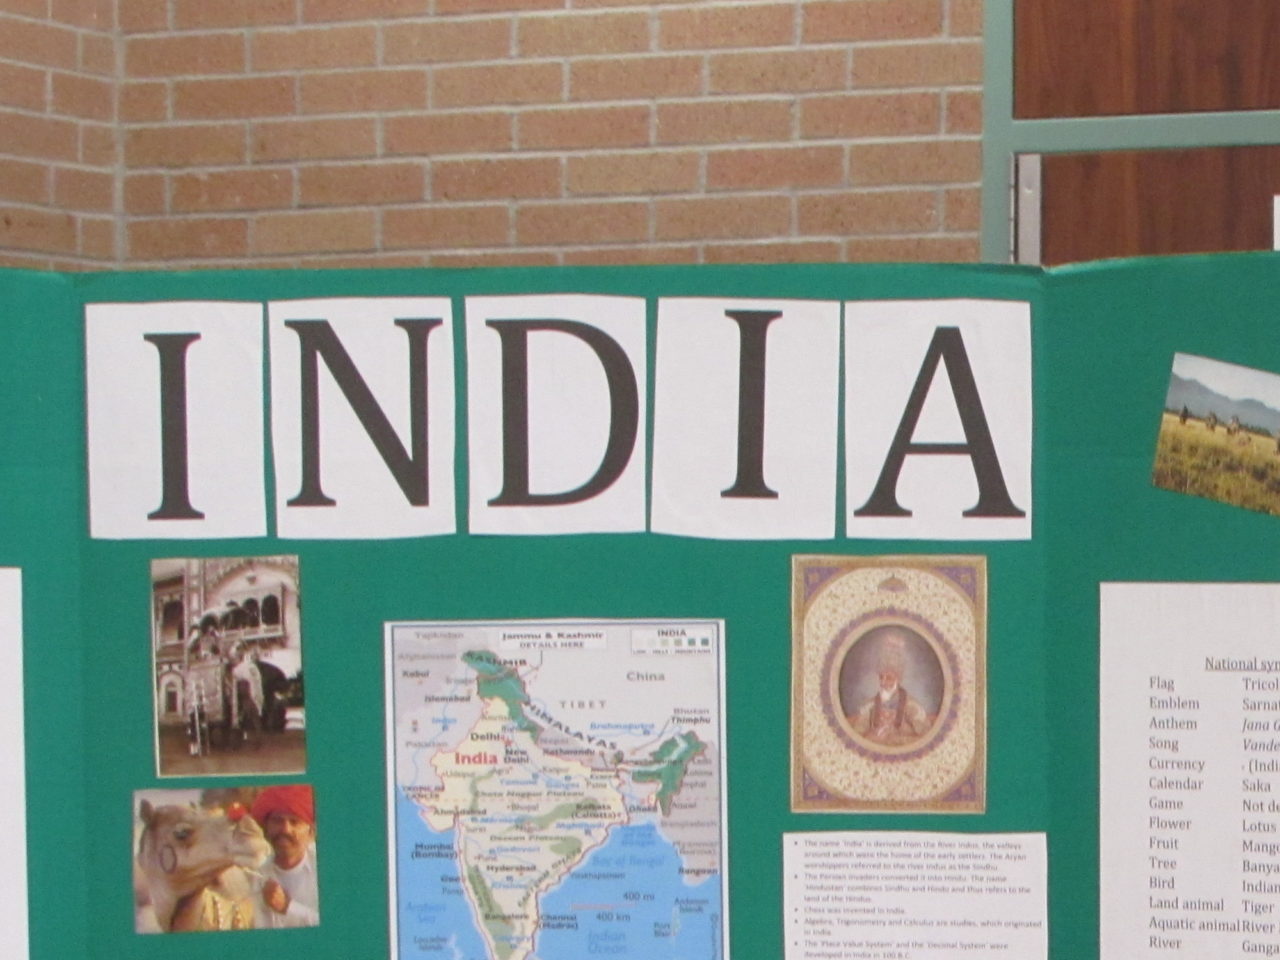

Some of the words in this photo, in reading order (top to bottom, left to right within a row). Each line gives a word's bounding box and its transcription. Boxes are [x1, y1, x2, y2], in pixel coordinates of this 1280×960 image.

[143, 309, 1026, 521] INDIA
[502, 631, 541, 640] Jammu
[557, 632, 604, 640] Kashmir
[1205, 657, 1258, 671] National
[627, 671, 665, 682] China
[1149, 677, 1174, 691] Flag
[560, 701, 607, 709] TIBET
[1149, 698, 1200, 710] Emblem
[672, 716, 711, 726] Thimphu
[1149, 717, 1197, 730] Anthem
[1243, 719, 1269, 732] Jana
[471, 732, 500, 742] Delhi
[1149, 738, 1178, 751] Song
[1243, 739, 1280, 752] Vande
[455, 752, 498, 765] India
[1149, 758, 1205, 771] Currency
[1149, 778, 1203, 790] Calendar
[1243, 779, 1271, 792] Saka
[1149, 798, 1183, 809] Game
[1243, 800, 1265, 812] Not
[1149, 817, 1191, 830] Flower
[1243, 820, 1276, 832] Lotus
[1149, 837, 1178, 849] Fruit
[411, 851, 458, 860] (Bombay)
[1149, 857, 1176, 869] Tree
[1149, 877, 1175, 889] Bird
[623, 892, 641, 901] 400
[1149, 897, 1178, 909] Land
[1182, 898, 1224, 911] animal
[1243, 901, 1274, 915] Tiger
[596, 913, 613, 922] 400
[616, 913, 630, 921] km
[1149, 917, 1195, 932] Aquatic
[1199, 919, 1240, 932] animal
[1243, 920, 1275, 933] River
[1149, 937, 1182, 949] River
[1243, 941, 1279, 955] Ganga
